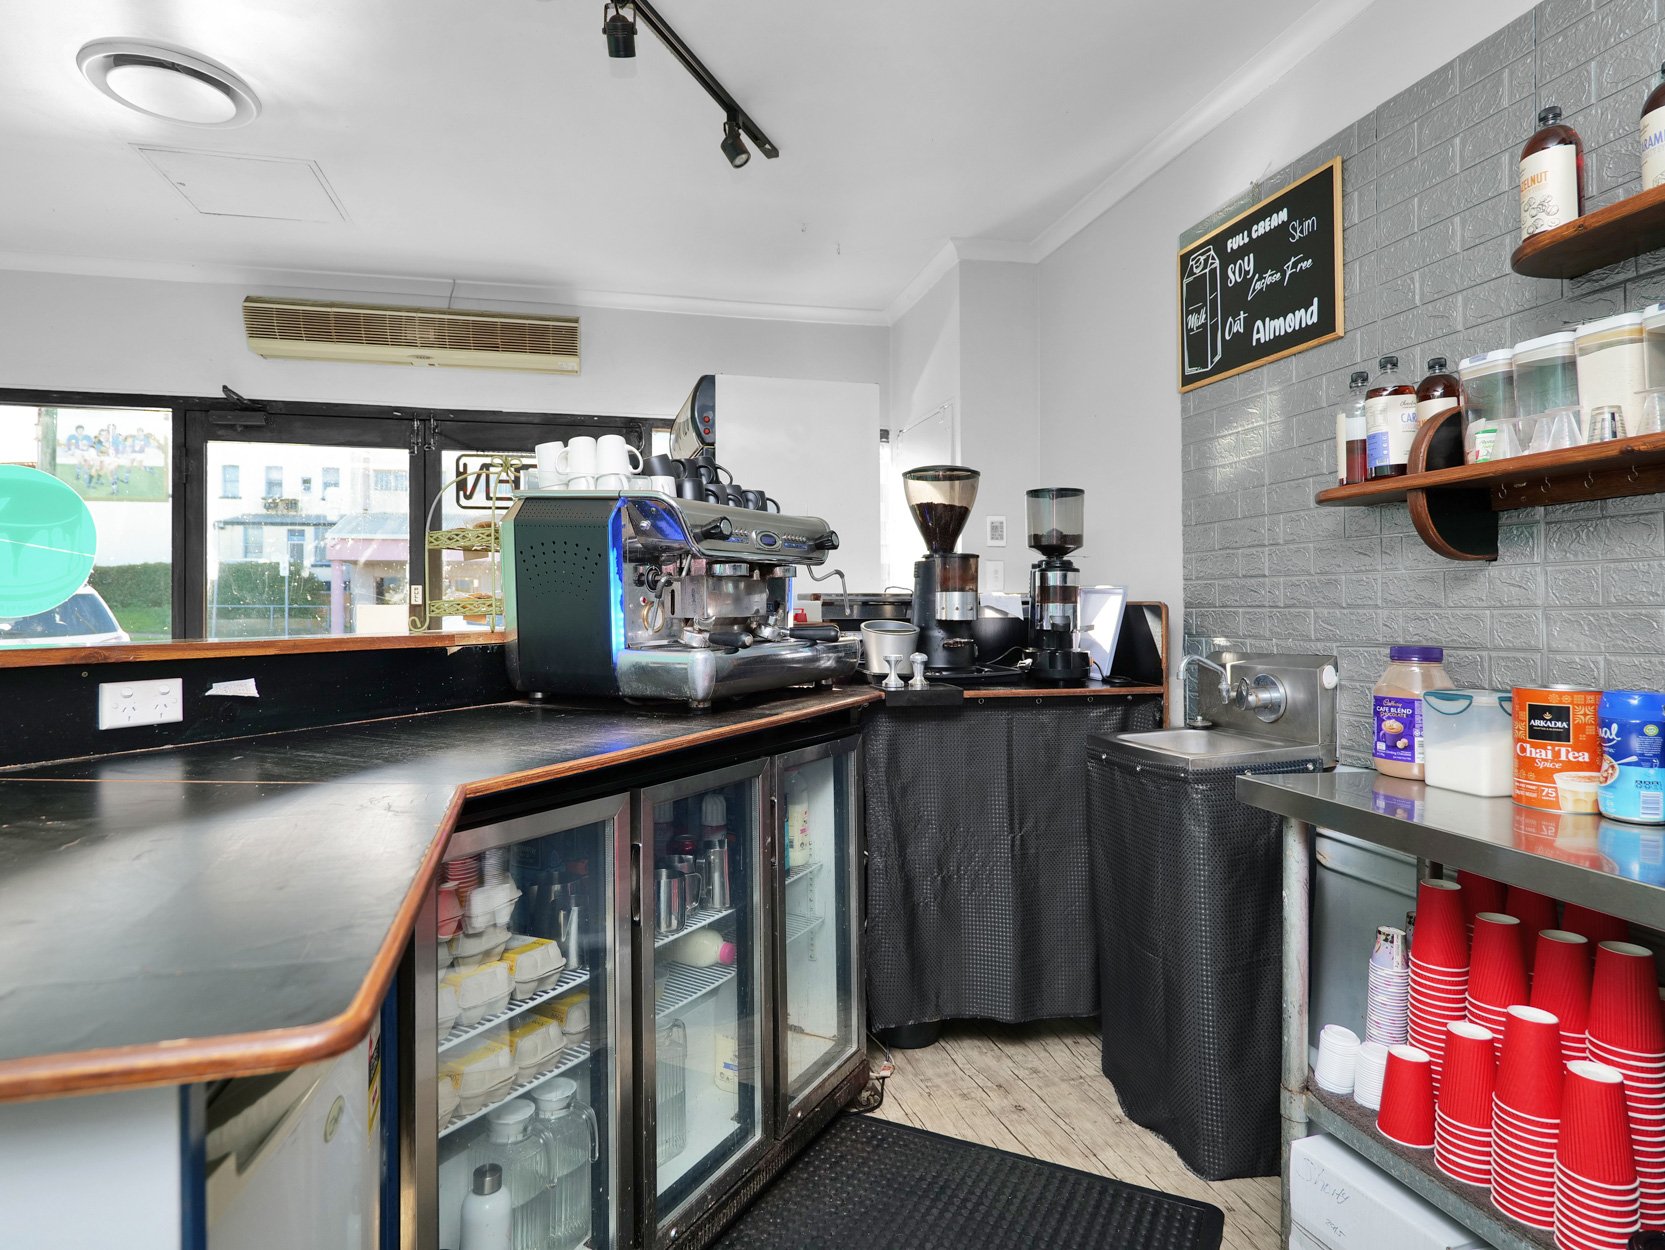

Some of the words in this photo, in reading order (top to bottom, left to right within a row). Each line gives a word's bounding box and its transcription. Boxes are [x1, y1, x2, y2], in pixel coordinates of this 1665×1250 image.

[1226, 229, 1249, 253] FULL
[1251, 207, 1288, 240] CREAM
[1288, 216, 1317, 243] Skim
[1247, 270, 1282, 301] Lactose
[1283, 254, 1313, 286] Free
[1186, 306, 1207, 331] Milk
[1225, 310, 1249, 341] Oat
[1252, 297, 1318, 346] Almond
[1376, 705, 1390, 713] CAFE
[1390, 707, 1413, 715] BLEND
[1529, 719, 1569, 729] ARKADIA
[1516, 742, 1553, 760] Chai
[1554, 746, 1590, 763] Tea
[1534, 758, 1563, 770] Spice
[1541, 787, 1556, 797] 75
